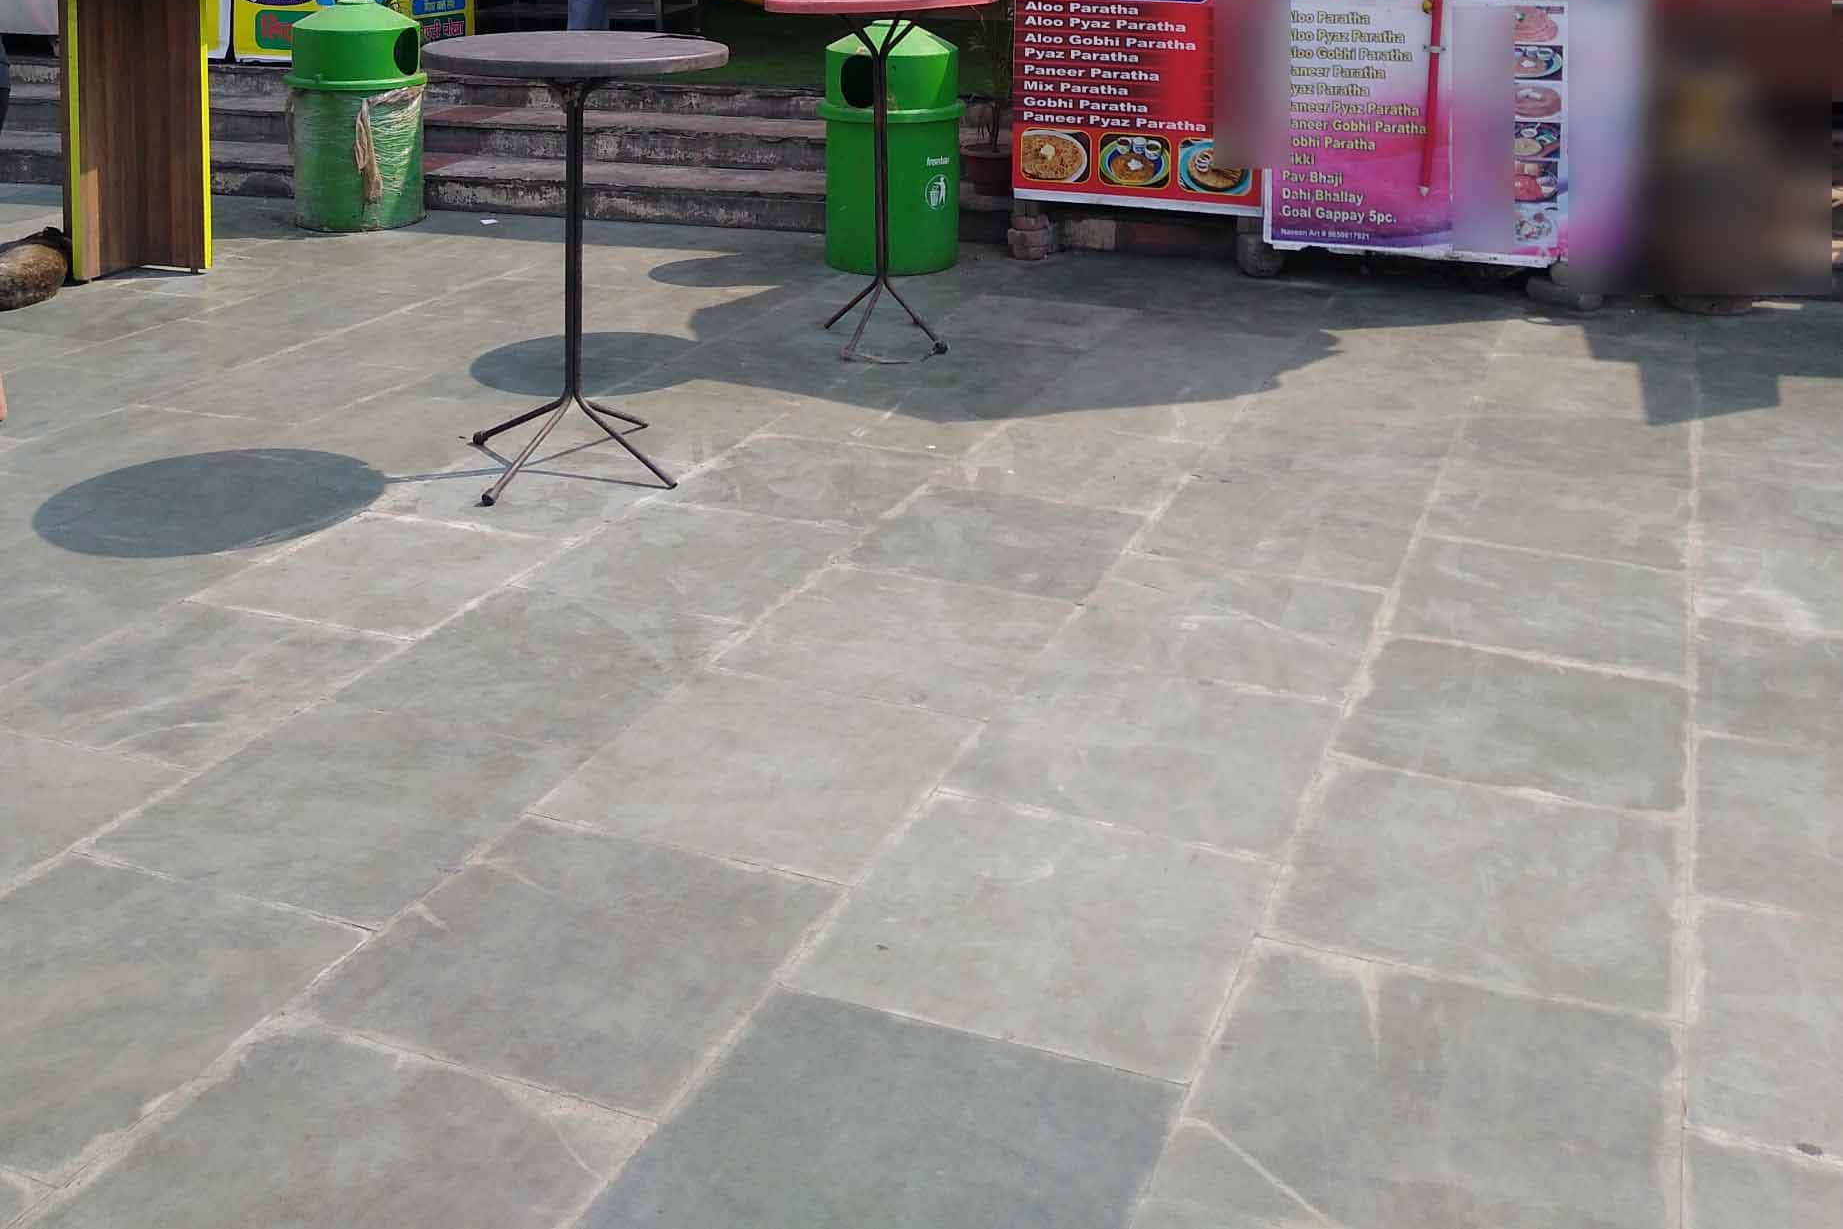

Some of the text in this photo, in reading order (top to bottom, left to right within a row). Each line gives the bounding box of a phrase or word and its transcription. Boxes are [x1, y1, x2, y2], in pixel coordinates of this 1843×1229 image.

[1025, 1, 1139, 16] Aloo Paratha
[1025, 16, 1187, 33] Aloo Pyaz Paratha
[1317, 11, 1370, 24] Paratha
[1025, 33, 1196, 51] Aloo Gobhi Paratha
[1317, 29, 1349, 44] Pyaz
[1352, 30, 1406, 44] Paratha
[1024, 48, 1139, 63] Pyaz Paratha
[1317, 48, 1356, 60] Gobhi
[1359, 49, 1414, 62] Paratha
[1024, 64, 1160, 82] Paneer Paratha
[1291, 66, 1386, 79] aneer Paratha
[1024, 81, 1129, 96] Mix Paratha
[1291, 83, 1370, 97] yaz Paratha
[1023, 97, 1148, 113] Gobhi Paratha
[1291, 101, 1419, 117] aneer Pyaz Paratha
[1023, 112, 1206, 132] Paneer Pyaz Paratha
[1291, 120, 1427, 135] aneer Gobhi Paratha
[1292, 136, 1376, 151] obhi Paratha
[1292, 152, 1315, 165] ikki
[1282, 170, 1343, 187] Pav Bhaji
[1282, 188, 1364, 205] Dahi Bhallay
[1282, 205, 1397, 225] Goal Gappay 5pc.
